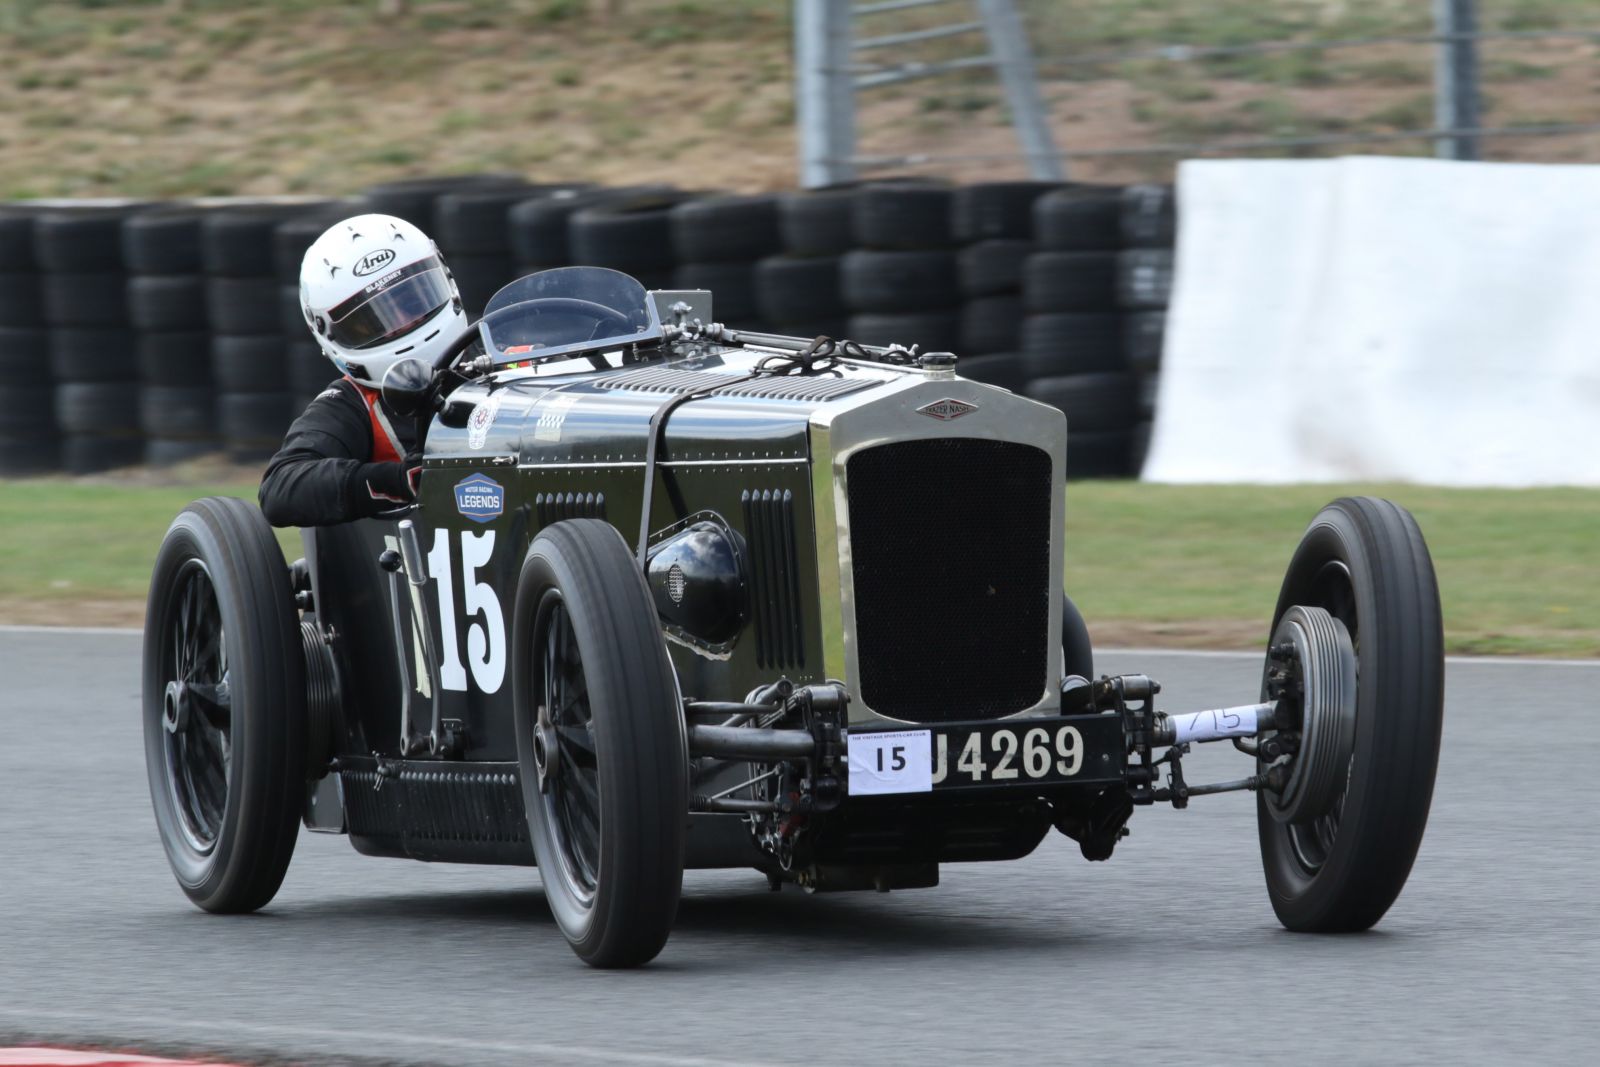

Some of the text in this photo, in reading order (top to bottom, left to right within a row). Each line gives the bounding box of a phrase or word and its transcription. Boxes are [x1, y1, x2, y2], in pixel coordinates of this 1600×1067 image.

[359, 249, 391, 273] Arai
[365, 269, 402, 294] BLAKENEY
[460, 495, 500, 508] LEGENDS
[428, 528, 507, 694] 15
[877, 746, 906, 772] 15
